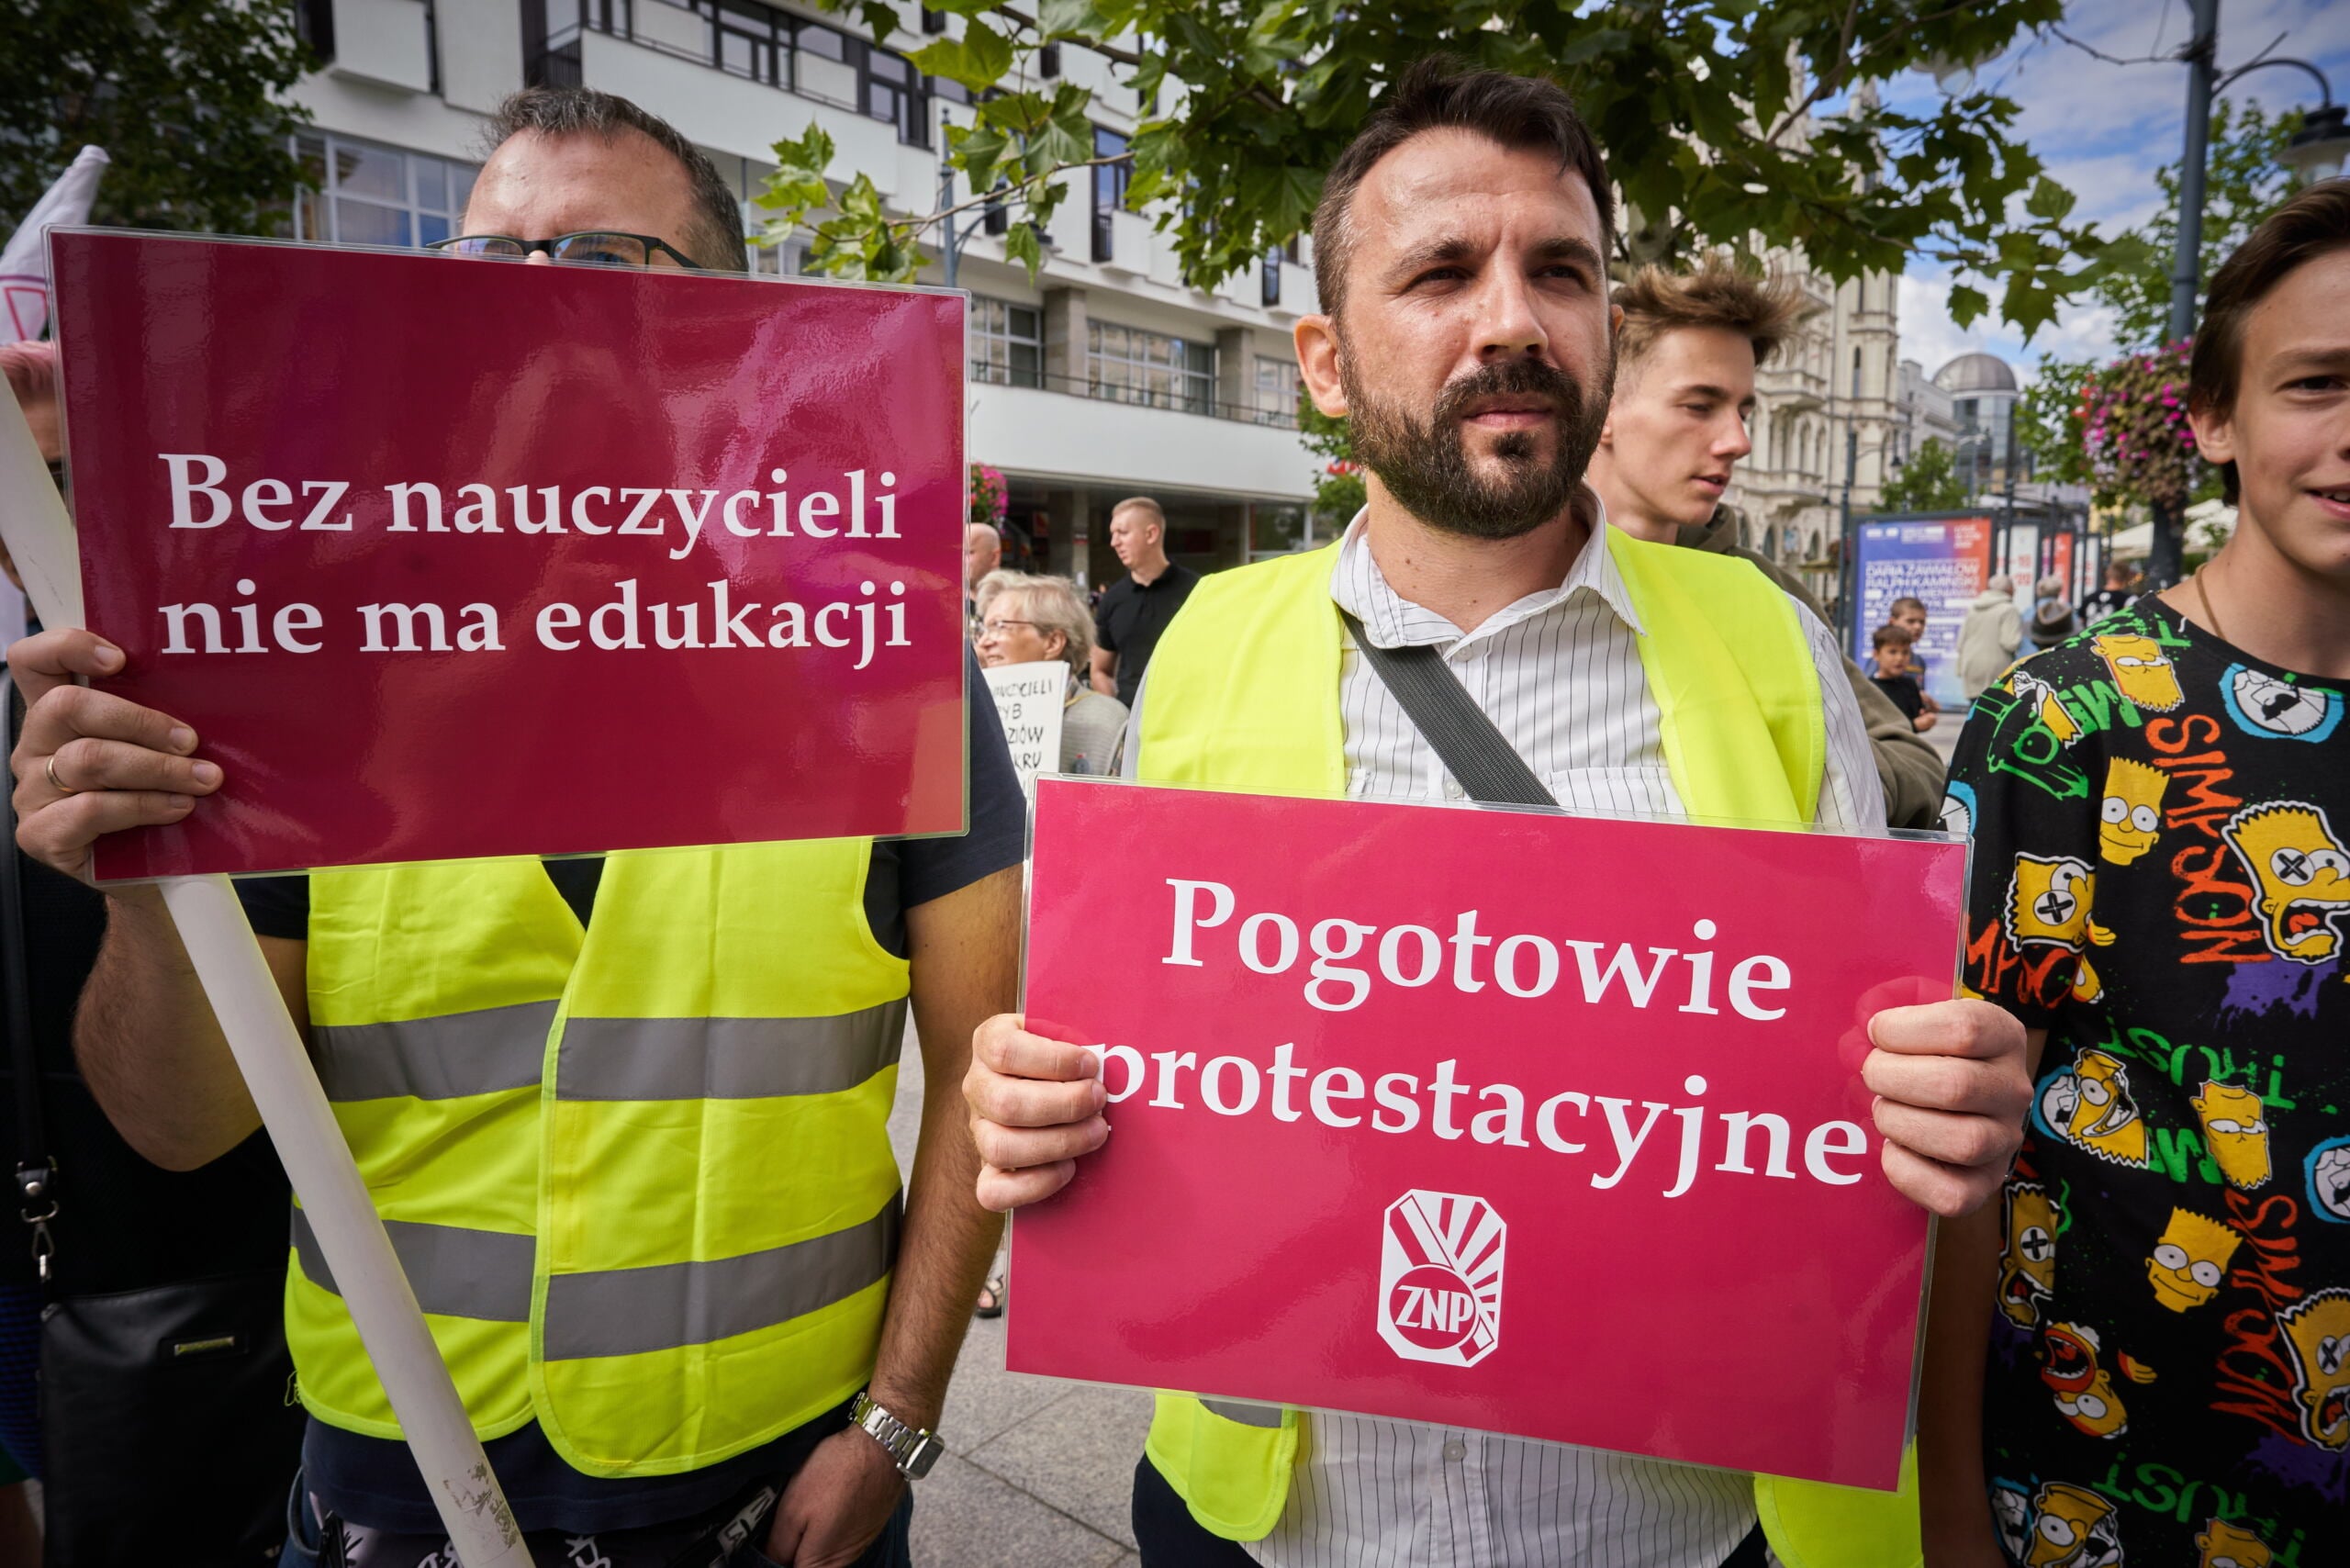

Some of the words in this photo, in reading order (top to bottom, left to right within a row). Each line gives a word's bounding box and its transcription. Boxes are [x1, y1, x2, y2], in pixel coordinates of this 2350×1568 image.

[158, 454, 352, 532] Bez
[384, 467, 902, 560] nauczycieli
[158, 578, 323, 654] nie
[356, 602, 506, 652] ma
[535, 578, 912, 670] edukacji
[1161, 878, 1792, 1021] Pogotowie
[1080, 1043, 1868, 1199] protestacyjne
[1394, 1284, 1474, 1334] ZNP
